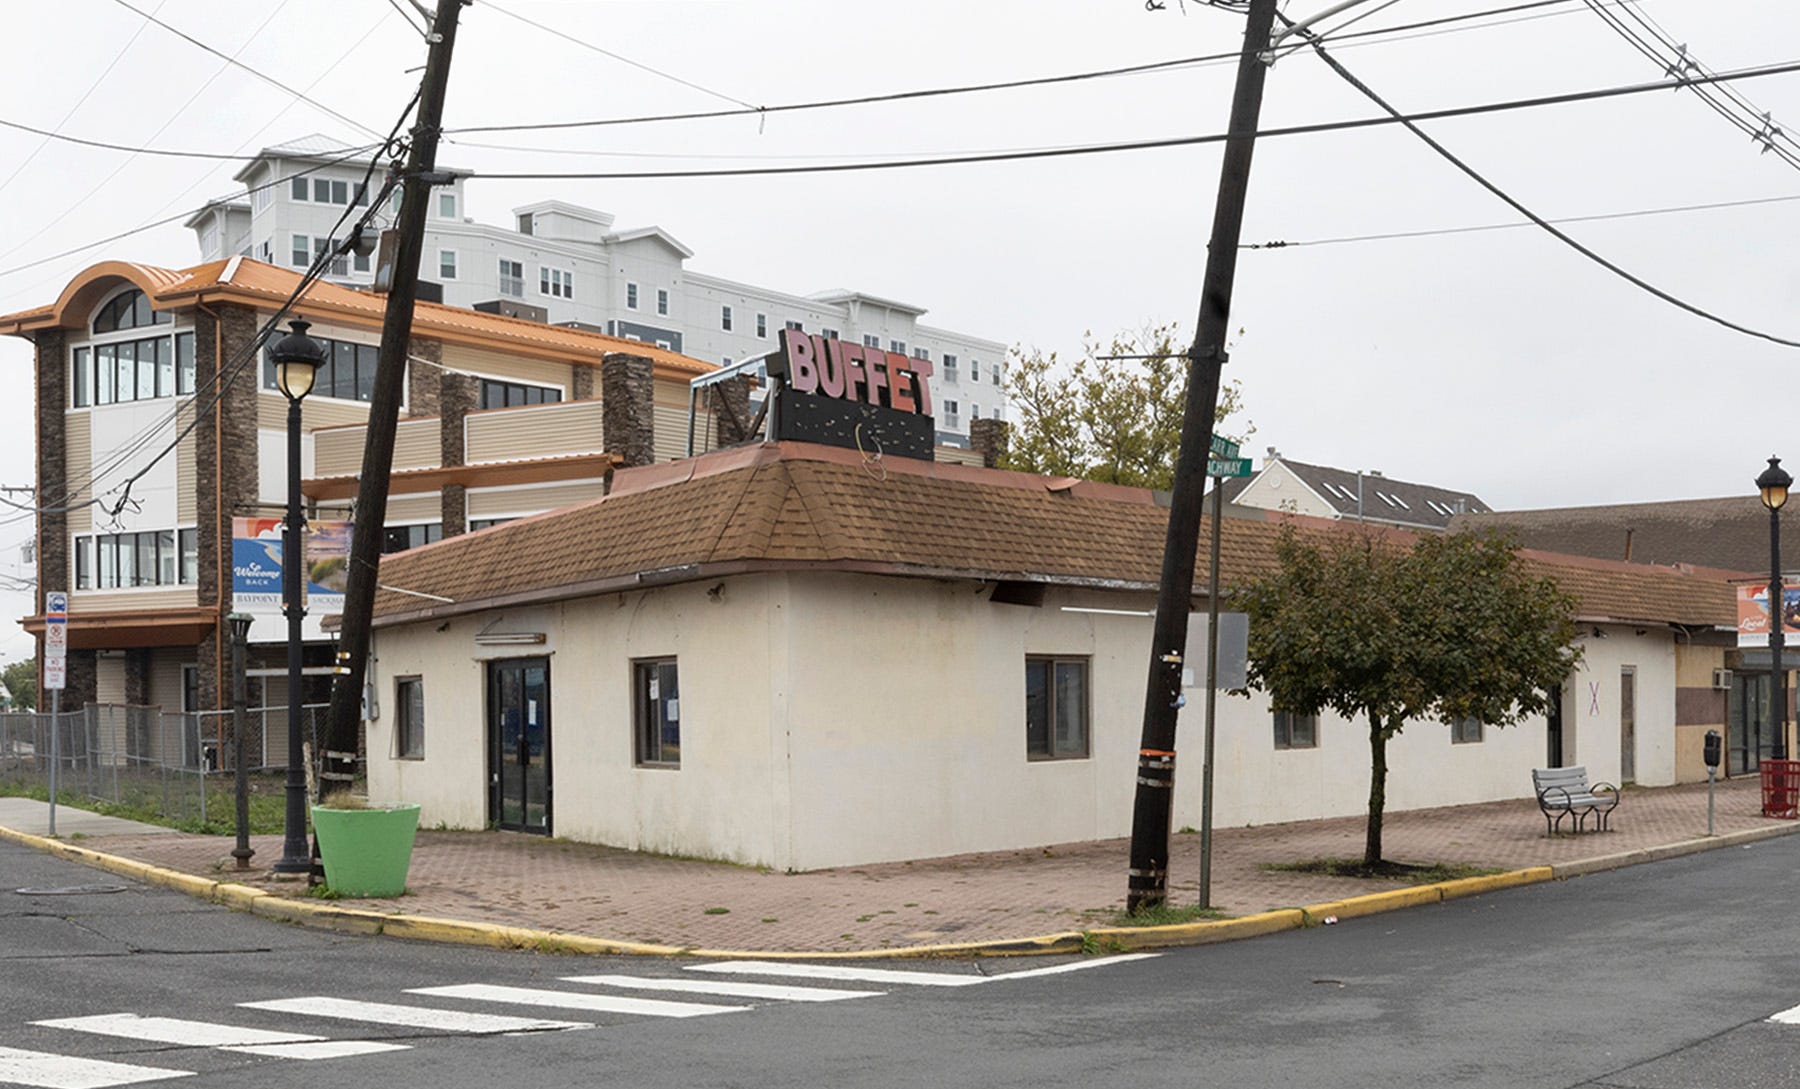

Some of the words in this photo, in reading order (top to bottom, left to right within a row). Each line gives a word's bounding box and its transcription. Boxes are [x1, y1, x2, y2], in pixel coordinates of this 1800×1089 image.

[786, 329, 934, 416] BUFFET
[234, 566, 280, 579] Welcome
[236, 594, 279, 603] BAYPOINT
[1739, 616, 1767, 631] Local
